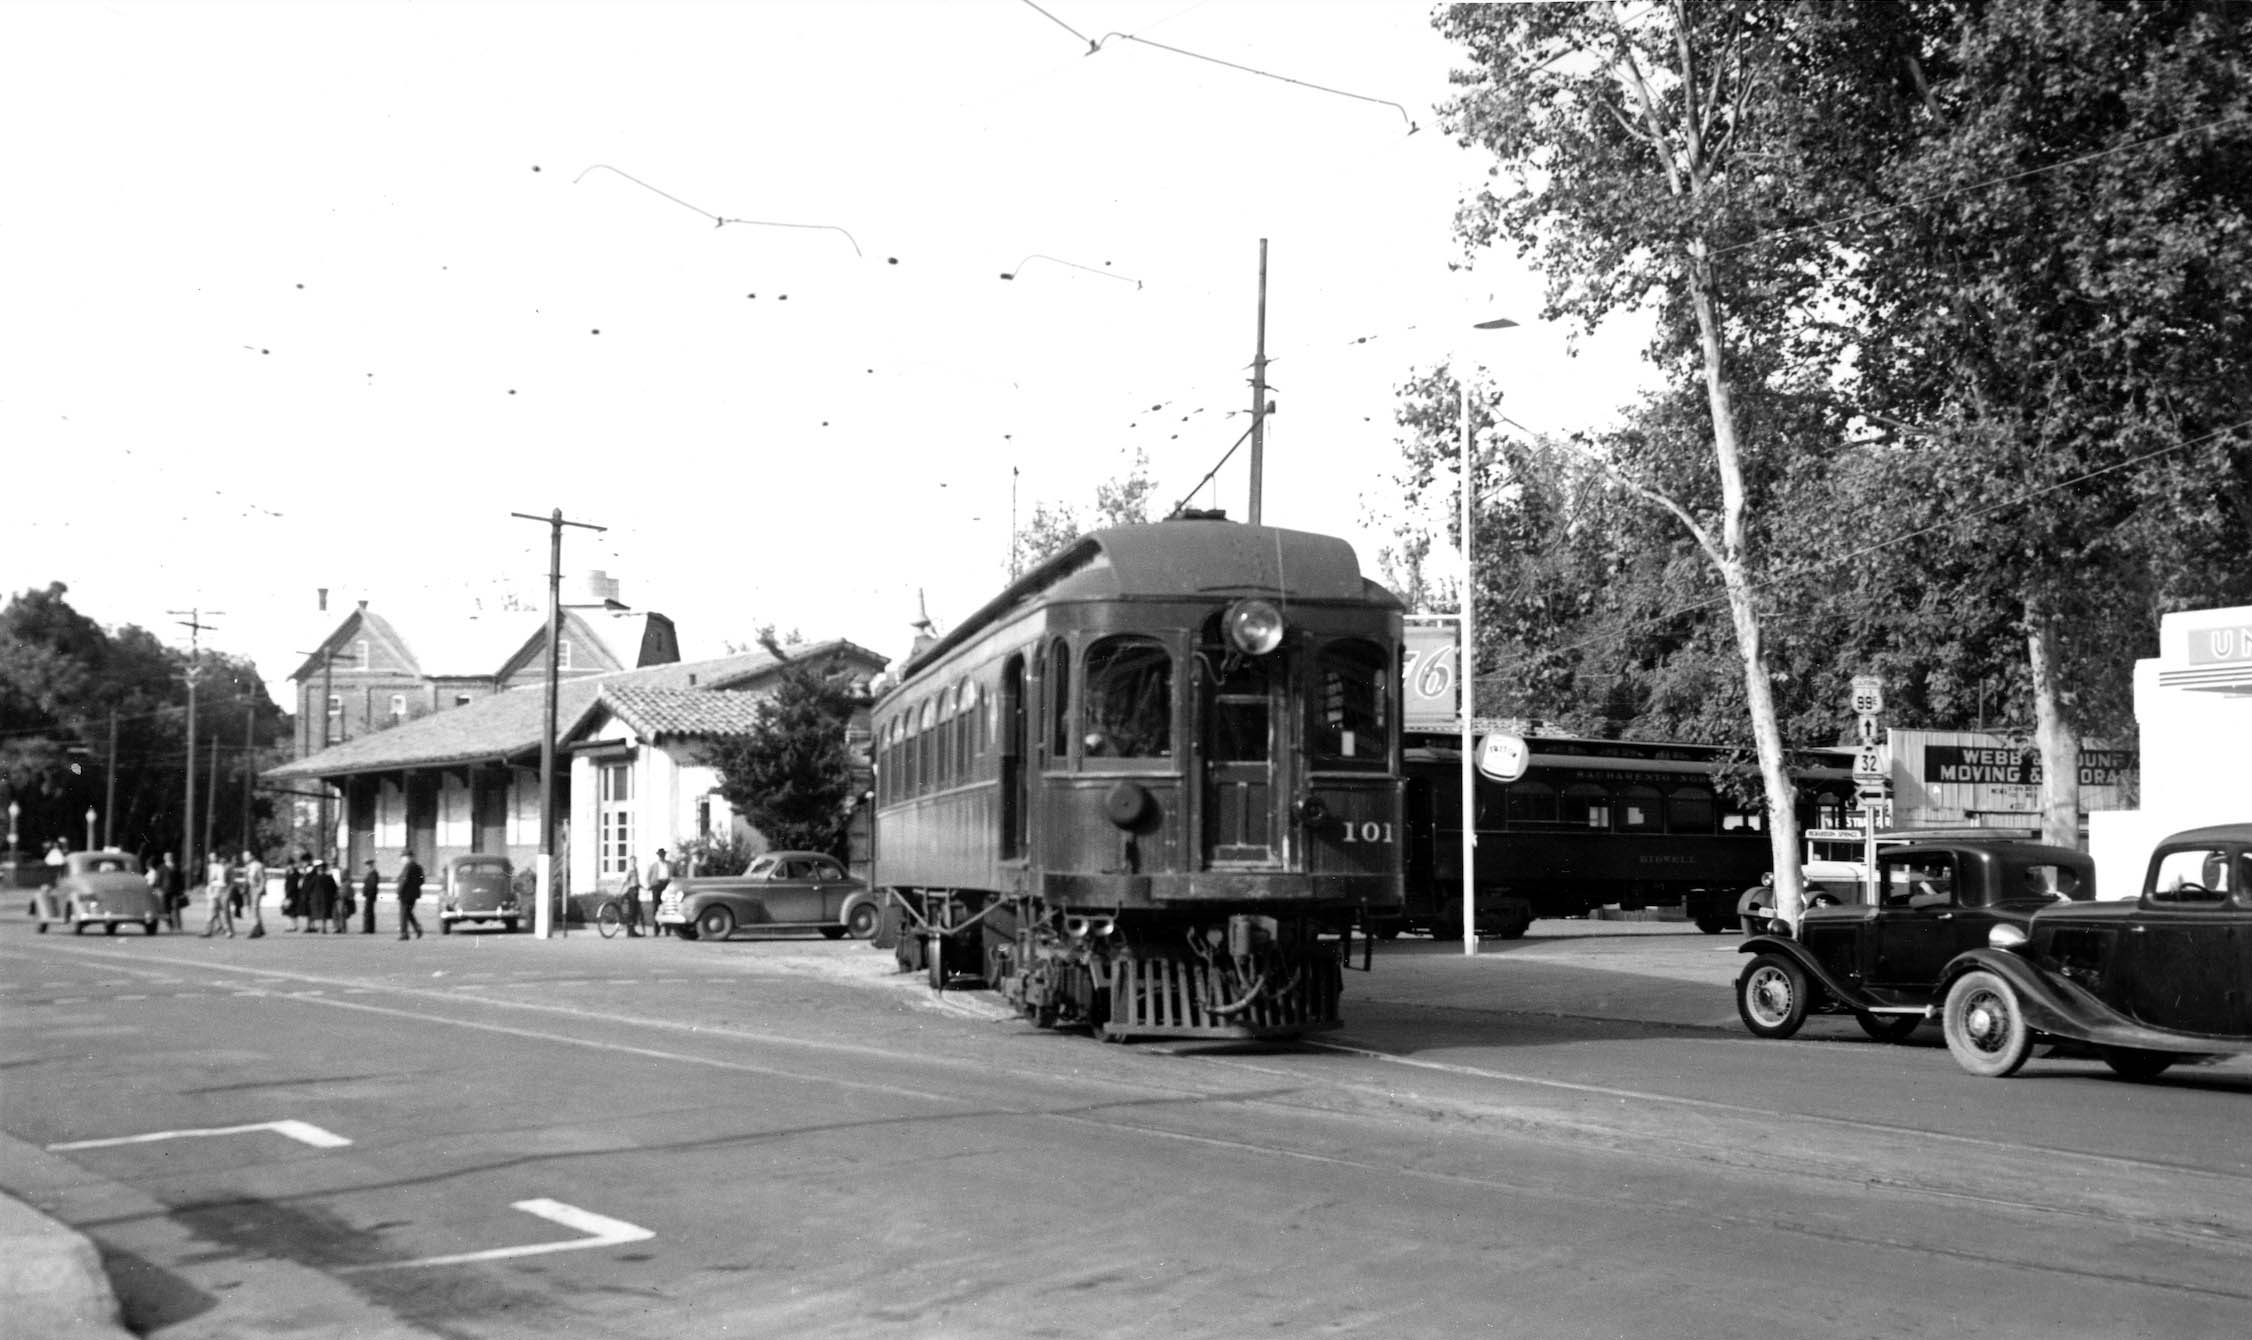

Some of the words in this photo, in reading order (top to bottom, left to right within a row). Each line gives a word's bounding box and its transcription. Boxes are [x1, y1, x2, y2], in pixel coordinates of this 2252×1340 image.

[1861, 754, 1878, 772] 32
[1962, 749, 2022, 766] WEBB
[1940, 764, 2021, 782] MOVING
[2029, 767, 2044, 784] &
[1343, 821, 1393, 843] 101
[1640, 855, 1697, 865] BIDWELL
